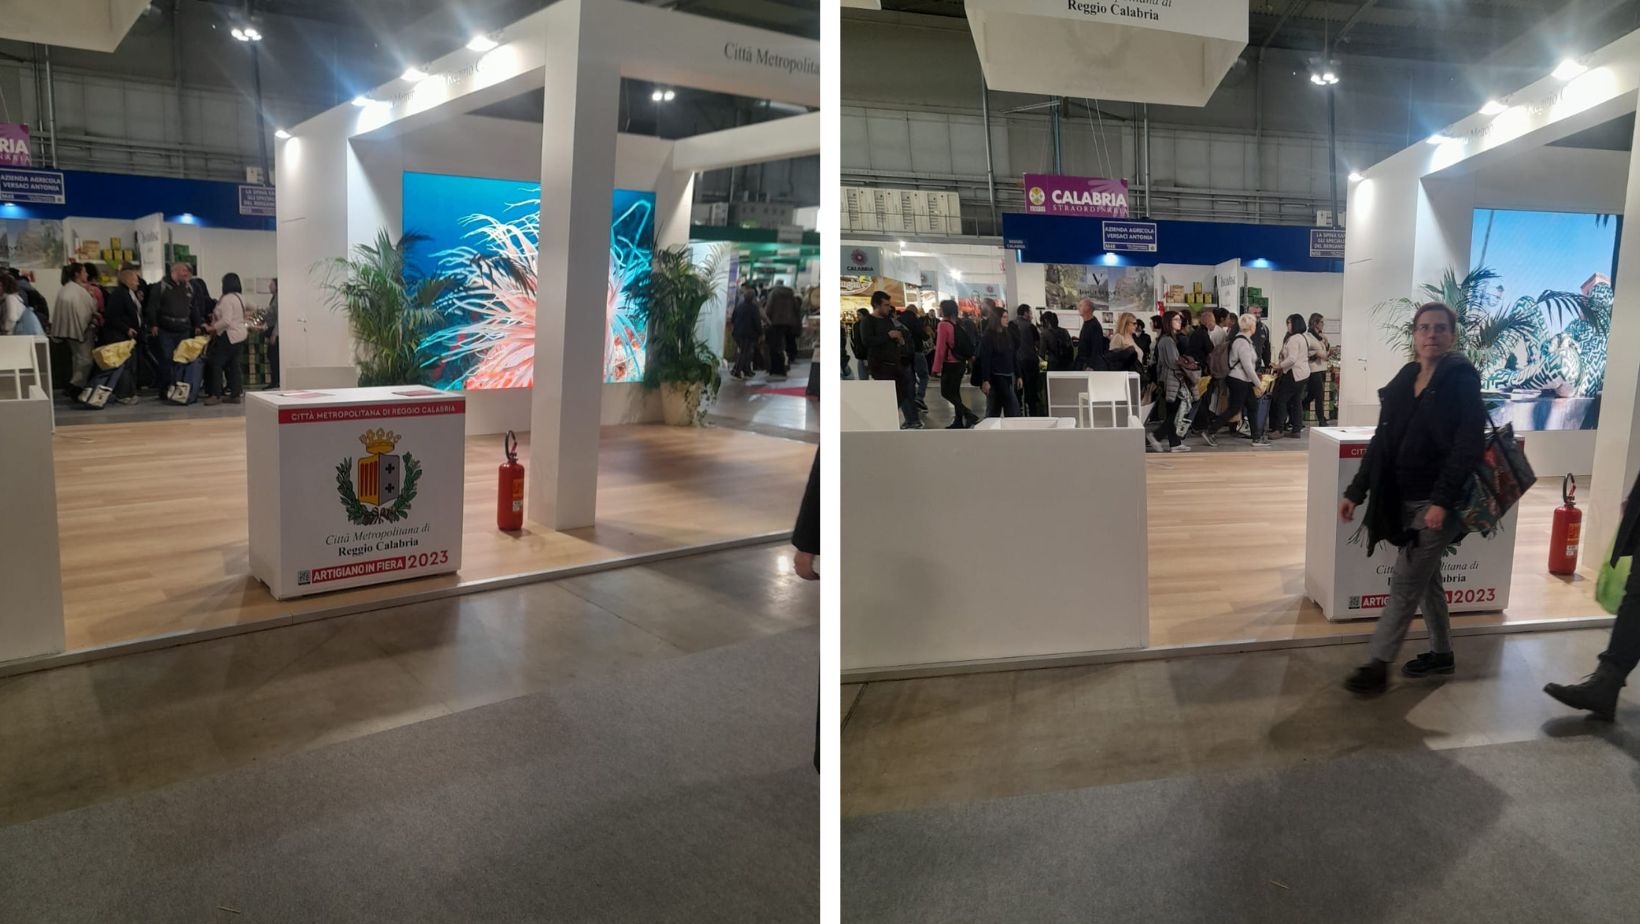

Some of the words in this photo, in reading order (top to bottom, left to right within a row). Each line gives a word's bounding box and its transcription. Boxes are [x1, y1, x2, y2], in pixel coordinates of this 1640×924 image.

[1067, 0, 1107, 15] Reggio
[1110, 3, 1159, 20] Calabria
[723, 42, 753, 63] Città
[1051, 189, 1128, 207] CALABRIA
[290, 410, 315, 421] CITTÀ
[316, 407, 381, 420] METROPOLITANA
[382, 406, 392, 416] DI
[392, 405, 420, 416] REGGIO
[421, 404, 456, 415] CALABRIA
[325, 534, 350, 546] Città
[352, 526, 419, 544] Metropolitana
[421, 523, 431, 534] di
[338, 543, 374, 557] Reggio
[375, 536, 419, 552] Calabria
[312, 566, 364, 582] ARTIGIANO
[365, 563, 376, 574] IN
[376, 557, 404, 572] FIERA
[407, 549, 449, 569] 2023
[1469, 560, 1479, 571] di
[1454, 587, 1496, 604] 2023
